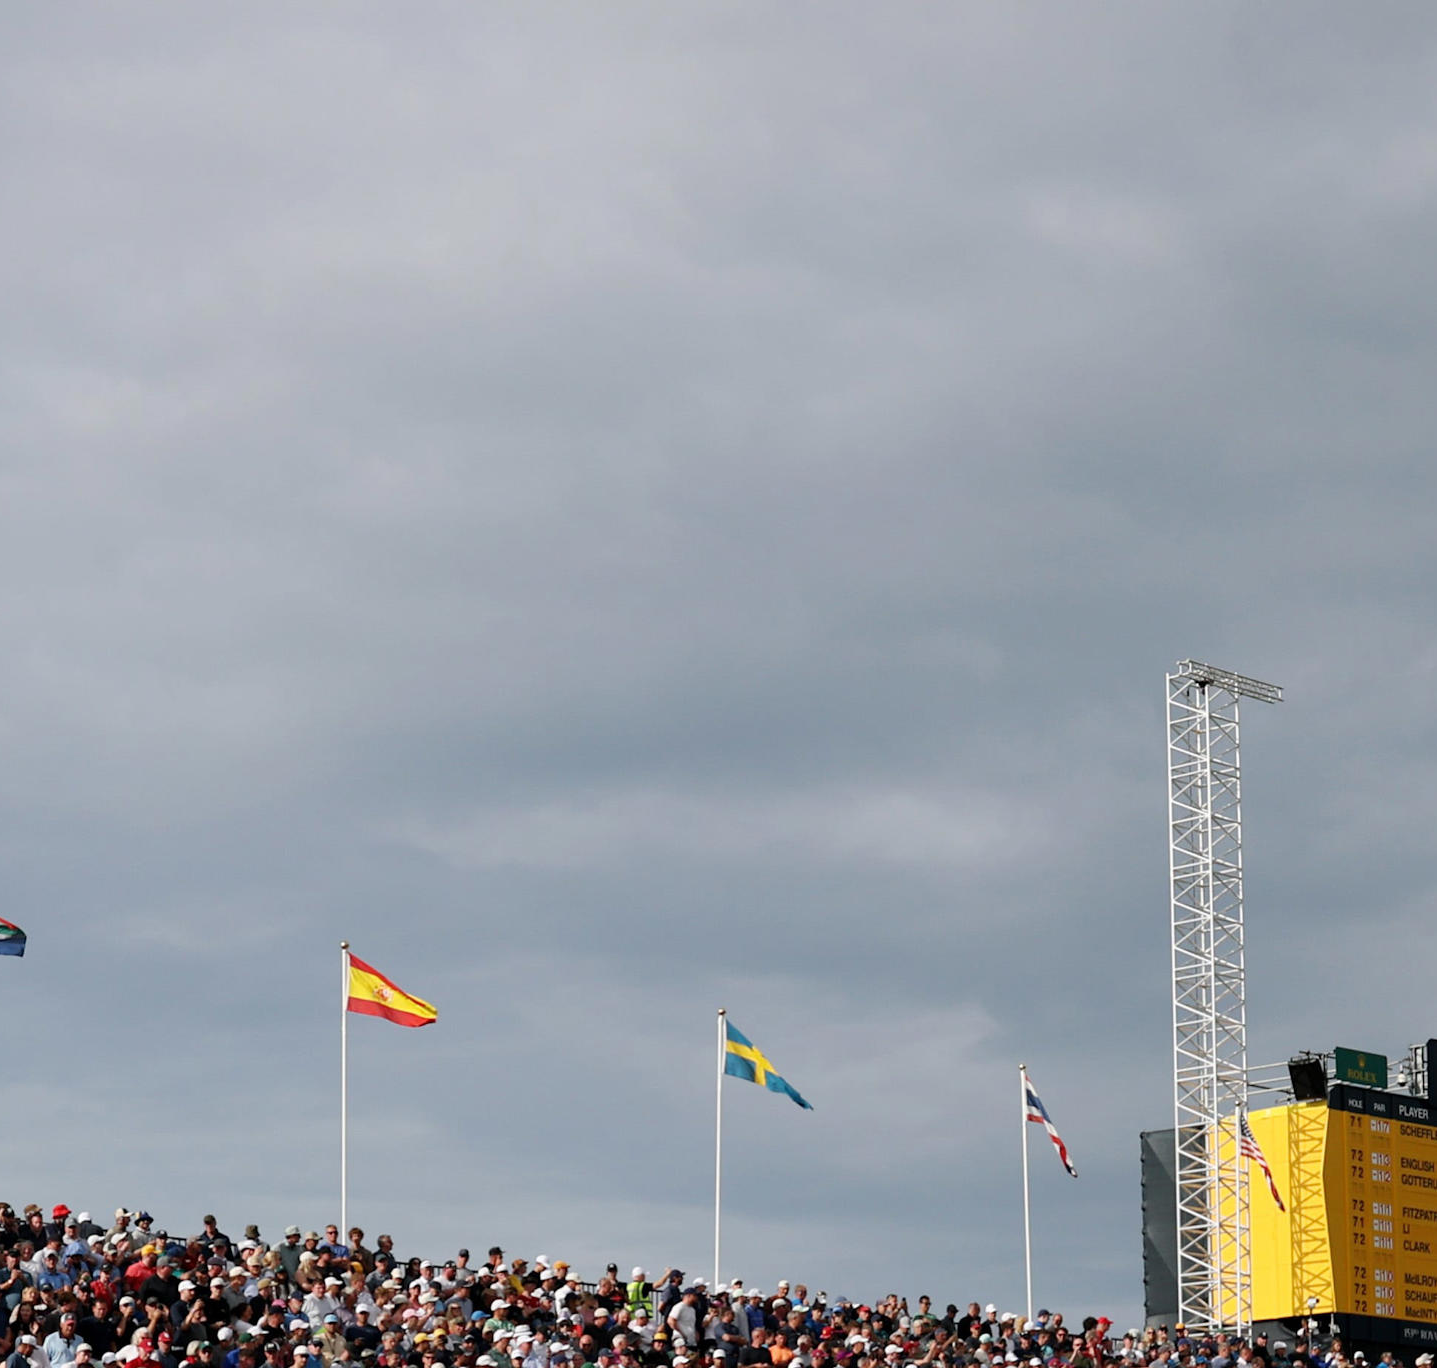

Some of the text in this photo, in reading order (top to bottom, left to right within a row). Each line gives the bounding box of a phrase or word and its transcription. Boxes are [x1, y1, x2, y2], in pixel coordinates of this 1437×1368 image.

[1347, 1068, 1377, 1083] ROLEX
[1348, 1099, 1363, 1109] HOLE
[1373, 1102, 1386, 1112] PAR
[1398, 1104, 1429, 1120] PLAYER
[1350, 1115, 1362, 1128] 71
[1351, 1149, 1364, 1162] 72
[1400, 1157, 1435, 1173] ENGLISH
[1351, 1165, 1364, 1178] 72
[1352, 1199, 1365, 1212] 72
[1352, 1216, 1365, 1229] 71
[1403, 1223, 1411, 1235] LI
[1353, 1233, 1366, 1245] 72
[1403, 1240, 1431, 1254] CLARK
[1354, 1266, 1366, 1279] 72
[1354, 1283, 1367, 1296] 72
[1355, 1300, 1367, 1312] 72
